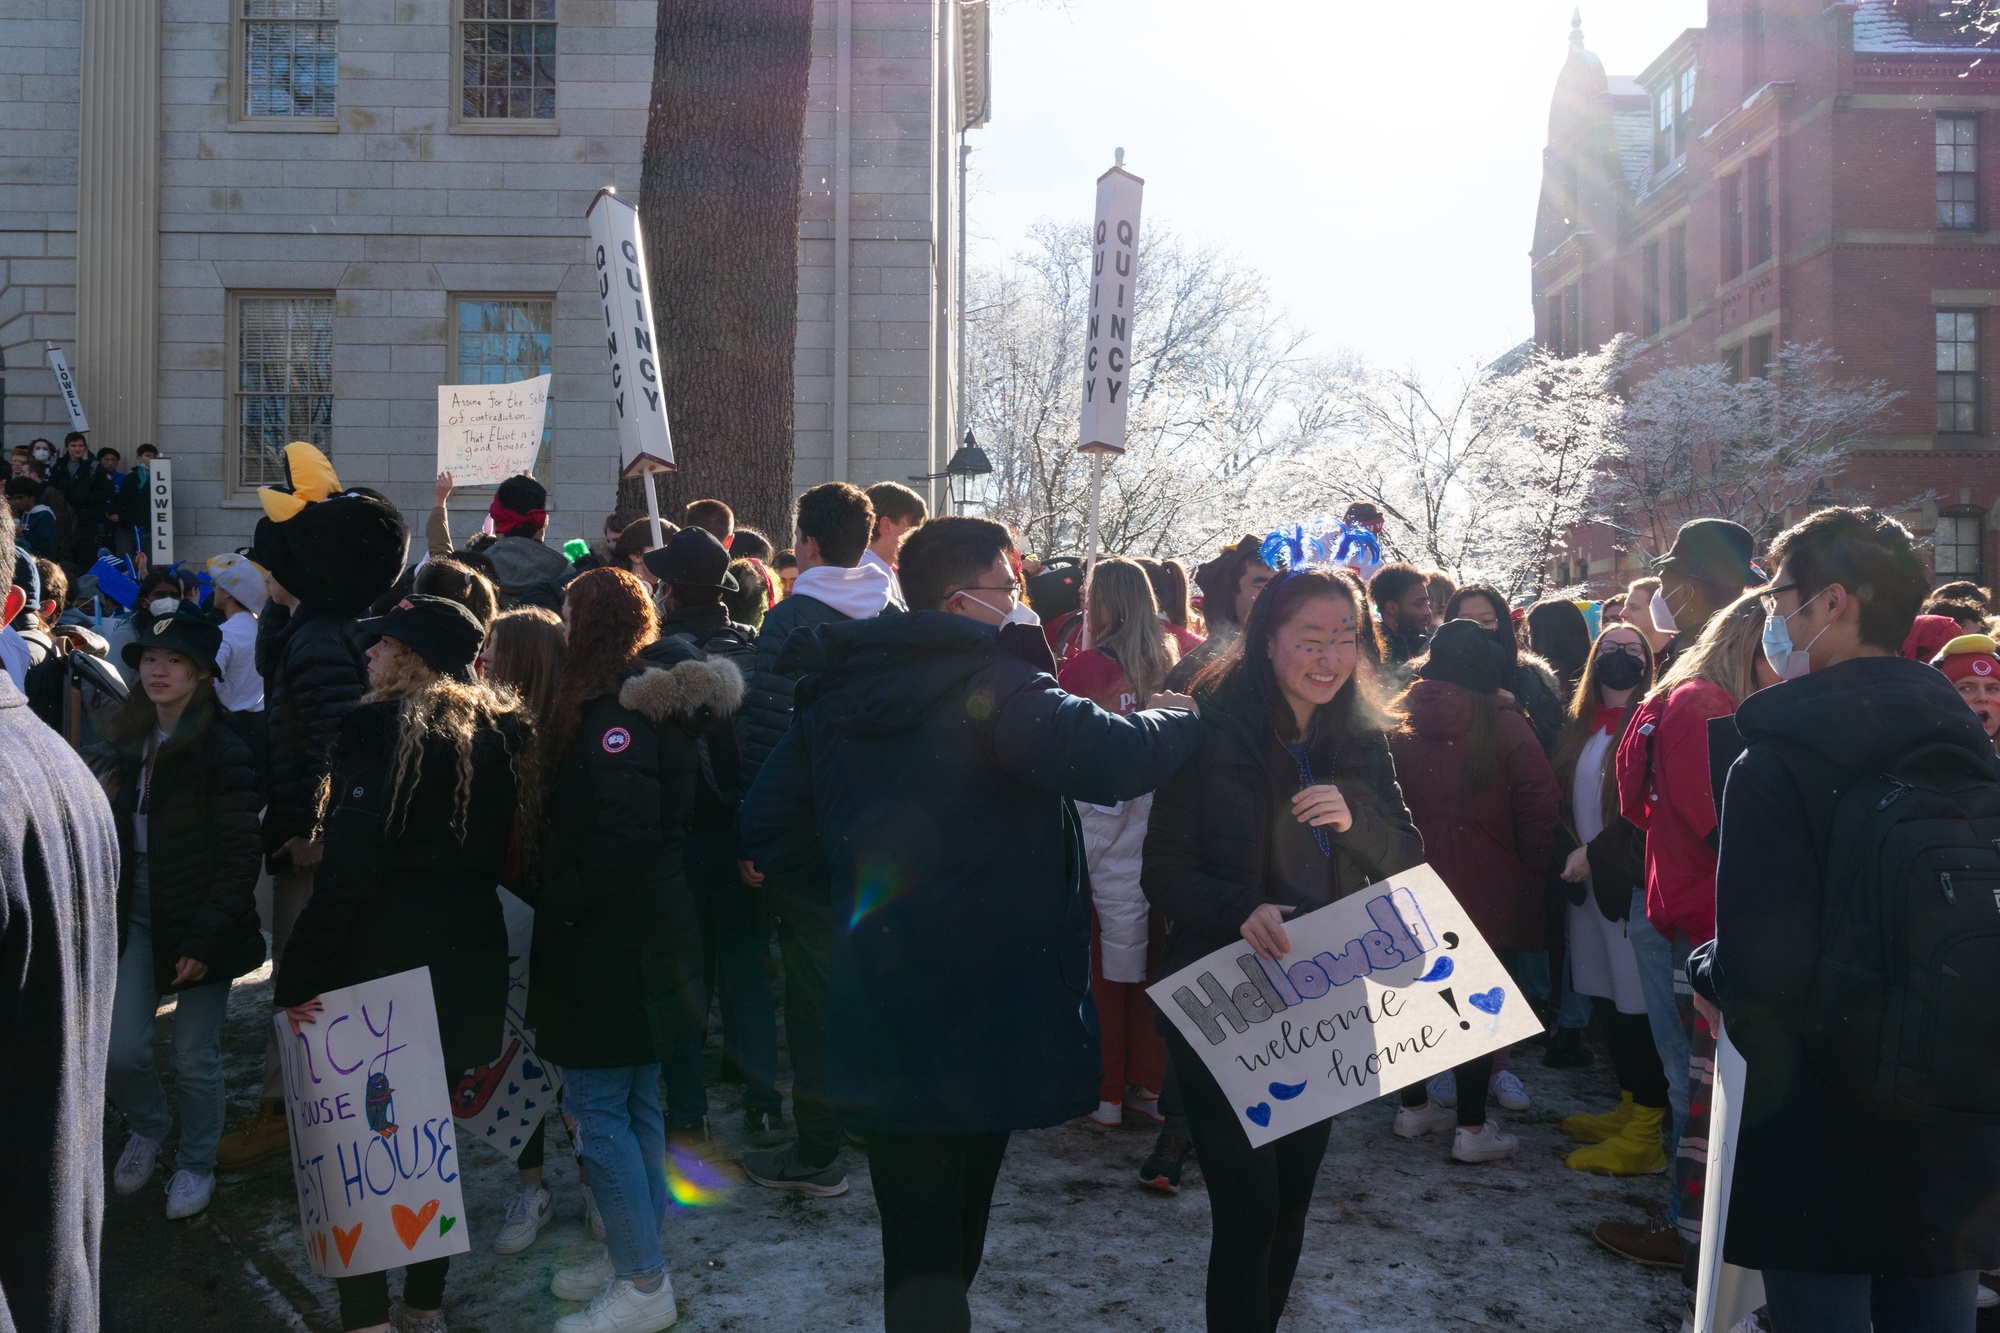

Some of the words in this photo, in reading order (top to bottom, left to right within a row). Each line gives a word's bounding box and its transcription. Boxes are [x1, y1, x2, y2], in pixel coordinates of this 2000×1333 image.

[596, 244, 625, 419] QUINCY
[621, 239, 659, 413] QUINCY
[1087, 219, 1106, 404] QUINCY
[1107, 219, 1133, 404] QUINCY
[57, 363, 81, 417] LOWELL
[451, 392, 482, 409] Assume
[488, 390, 503, 409] for
[507, 390, 523, 409] the
[464, 443, 492, 461] good
[520, 431, 528, 440] is
[154, 471, 169, 550] LOWELL
[1234, 990, 1407, 1072] welcome
[336, 1117, 459, 1208] HOUSE
